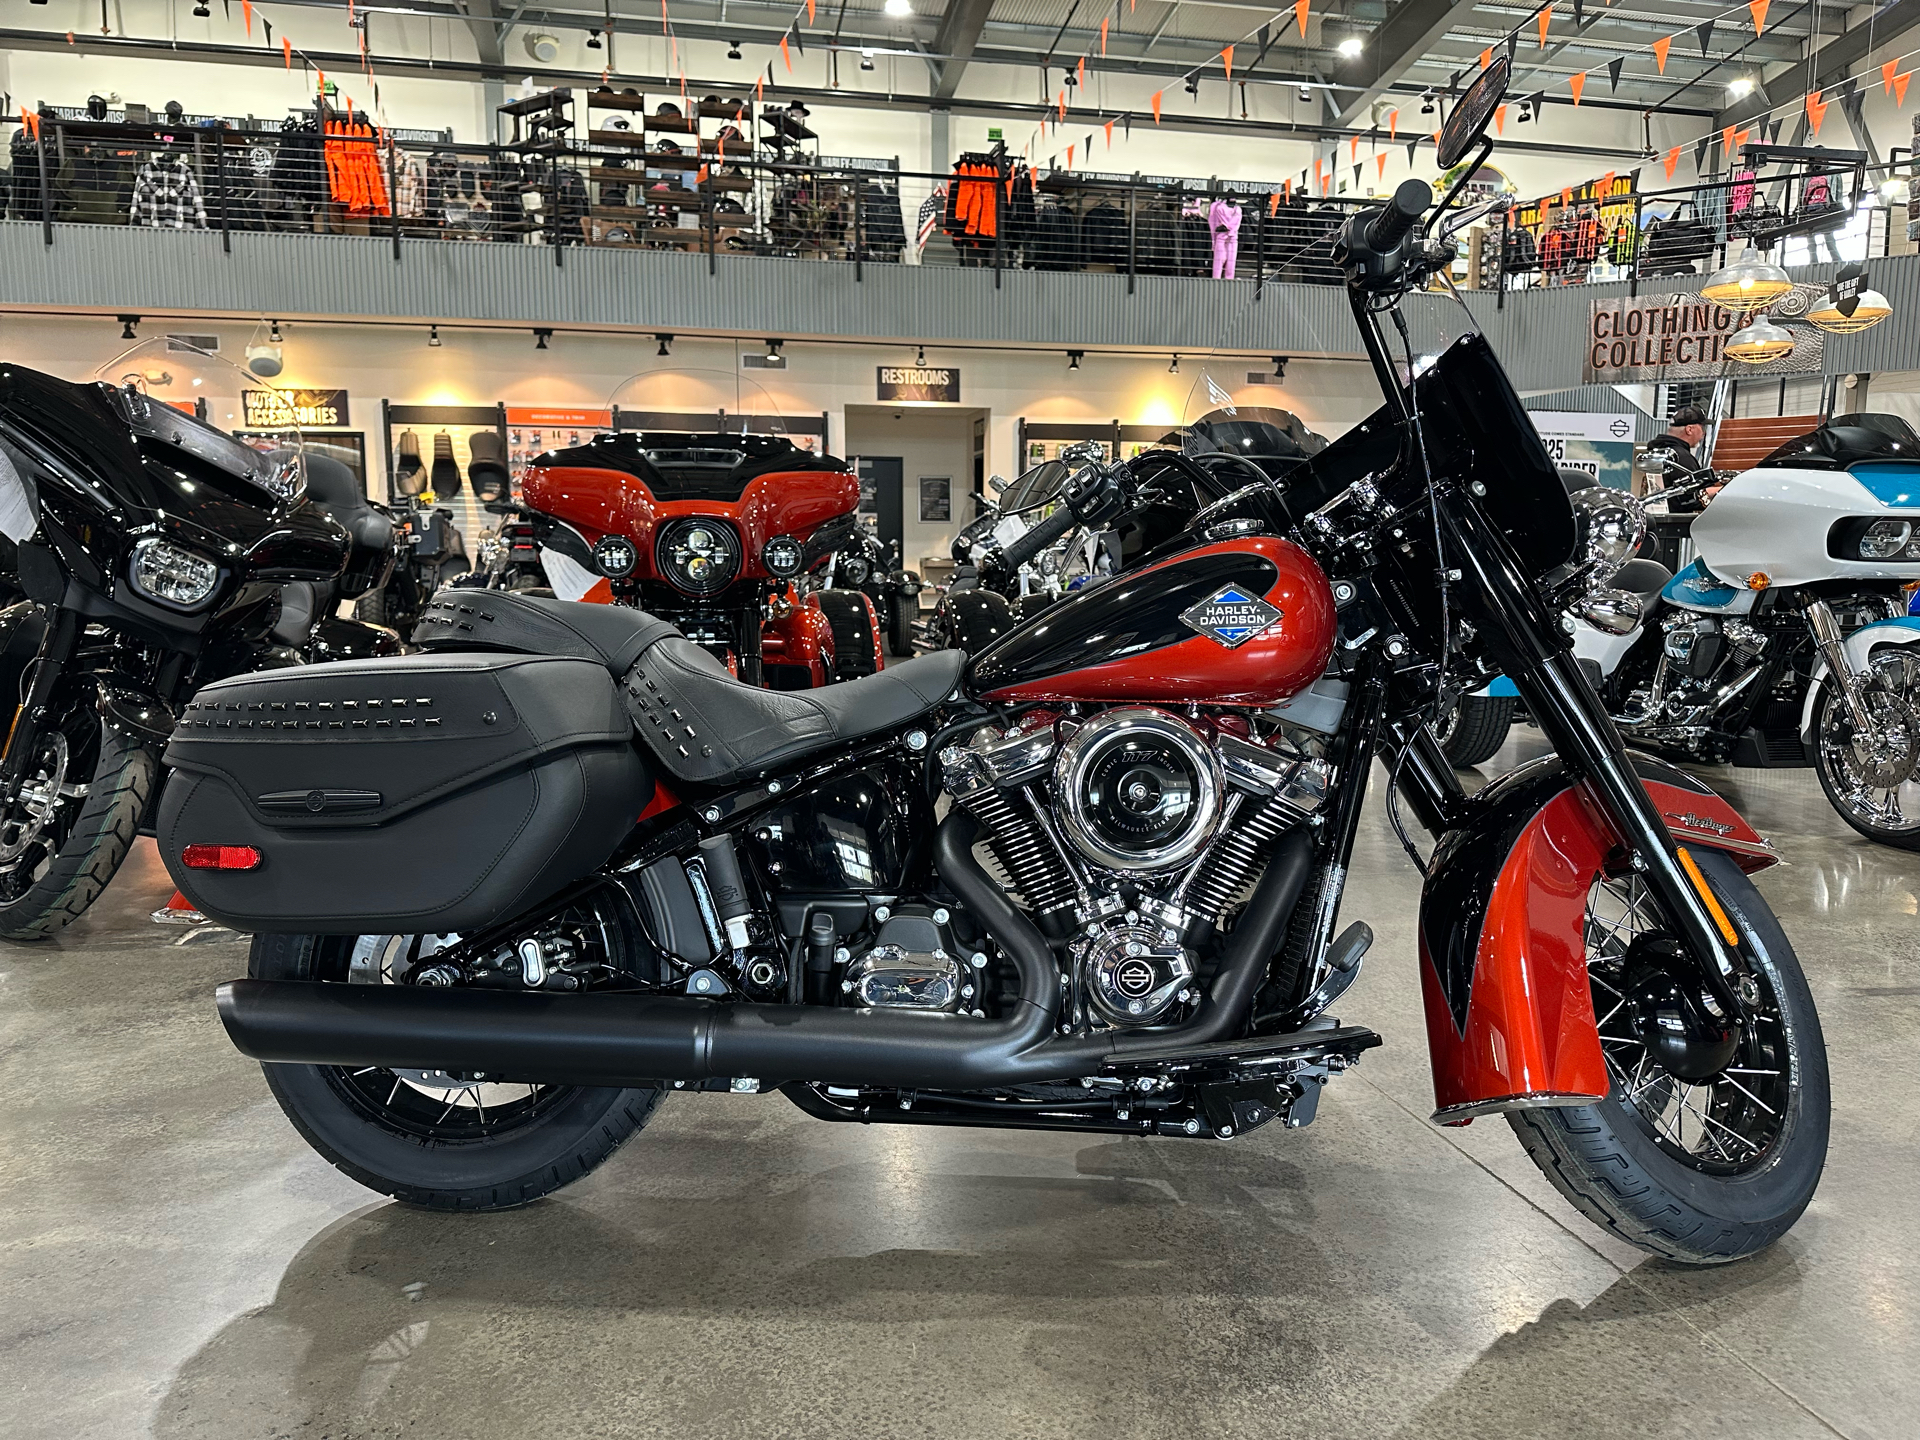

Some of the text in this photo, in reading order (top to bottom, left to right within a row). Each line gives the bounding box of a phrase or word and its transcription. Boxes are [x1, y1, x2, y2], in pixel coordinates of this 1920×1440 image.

[1593, 304, 1731, 339] CLOTHING
[881, 368, 950, 386] RESTROOMS
[1199, 614, 1266, 626] DAVIDSON
[1206, 605, 1261, 616] HARLEY-
[1101, 750, 1176, 777] CUBIC 117 INCHES
[1685, 812, 1739, 835] Heritage
